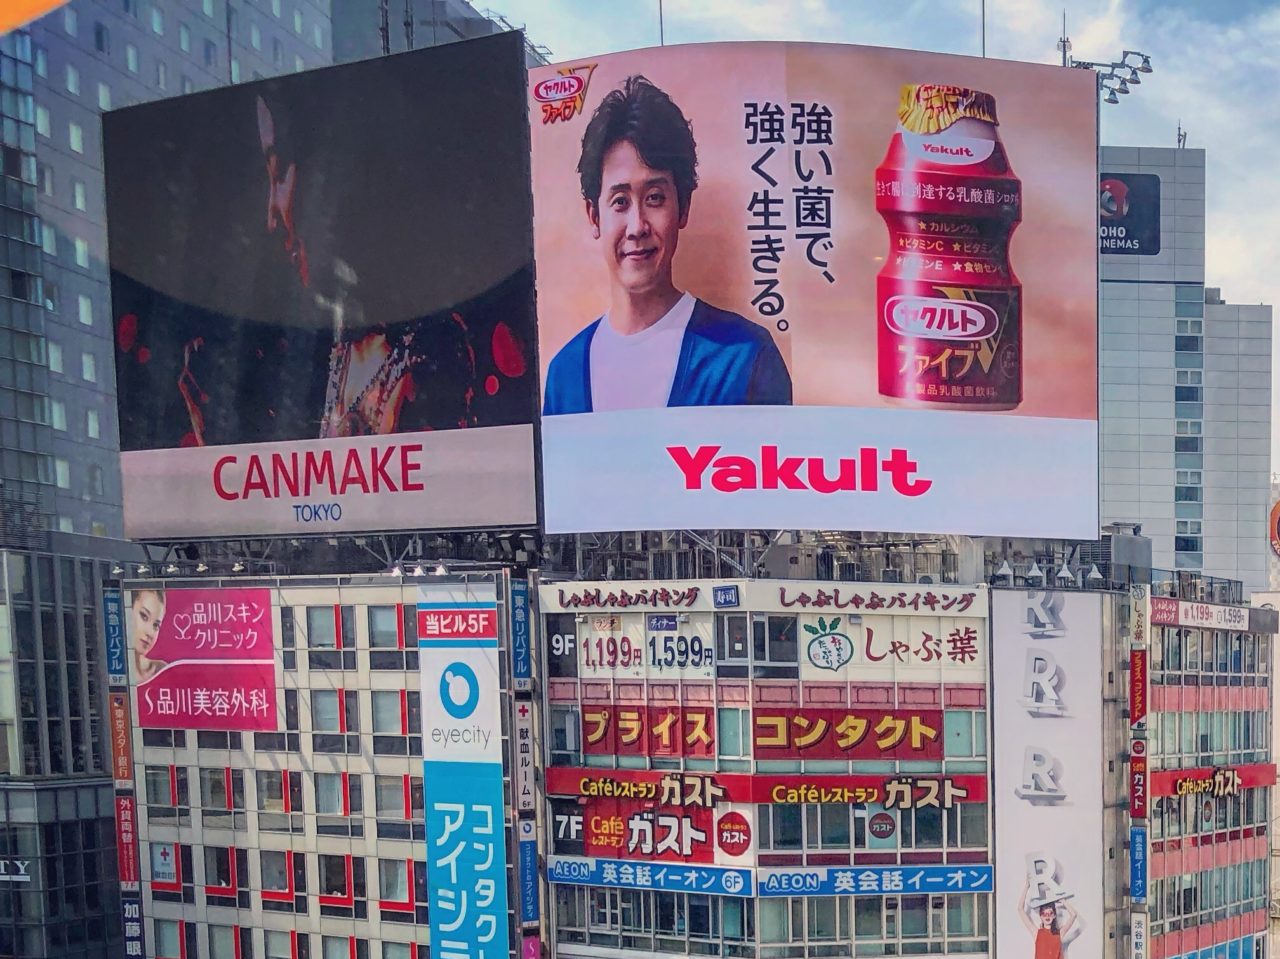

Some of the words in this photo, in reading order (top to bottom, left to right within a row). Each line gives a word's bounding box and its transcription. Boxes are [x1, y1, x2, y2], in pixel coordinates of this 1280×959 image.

[543, 80, 575, 97] ヤクルト
[922, 144, 974, 157] Yakult
[791, 102, 836, 284] 強い菌で、
[744, 102, 790, 333] 強く生きる。
[930, 222, 979, 234] カルシウム
[904, 238, 944, 252] ビタミンC
[1099, 226, 1126, 238] OHO
[900, 305, 978, 332] ヤクルト
[898, 343, 981, 378] ファイブ
[906, 383, 998, 398] 製品乳酸菌飲料
[213, 444, 425, 500] CANMAKE
[667, 445, 933, 497] Yakult
[293, 503, 342, 522] TOKYO
[557, 586, 700, 608] しゃぶしゃぶバイキング
[779, 586, 977, 611] しゃぶしゃぶバイキング
[192, 602, 265, 626] 品川スキン
[425, 612, 489, 636] 当ビル5F
[650, 617, 676, 629] ディナー
[1133, 601, 1144, 641] しゃぶ葉
[106, 602, 123, 671] 東急リバブル
[194, 628, 258, 650] クリニック
[513, 595, 528, 673] 東急リバブル
[552, 633, 575, 657] 9F
[865, 627, 978, 664] しゃぶ葉
[583, 636, 642, 672] 1,199円
[649, 635, 713, 672] 1,599円
[517, 680, 528, 688] 9F
[157, 687, 270, 717] 品川美容外科
[431, 725, 491, 749] eyecity
[584, 709, 714, 749] プライス
[756, 715, 938, 750] コンタクト
[114, 708, 129, 778] 東京スター銀行
[519, 727, 531, 796] 献血ルーム
[660, 774, 726, 807] ガスト
[885, 778, 968, 810] ガスト
[1133, 773, 1144, 810] ガスト
[1213, 769, 1243, 796] ガスト
[120, 798, 133, 844] 外貨両替
[555, 815, 583, 839] 7F
[591, 816, 624, 835] Café
[628, 812, 707, 854] ガスト
[591, 836, 625, 848] レストラン
[722, 831, 748, 843] ガスト
[554, 861, 590, 880] AEON
[601, 863, 716, 889] 英会話イーオン
[723, 874, 742, 892] 6F
[767, 873, 820, 891] AEON
[834, 869, 988, 893] 英会話イーオン
